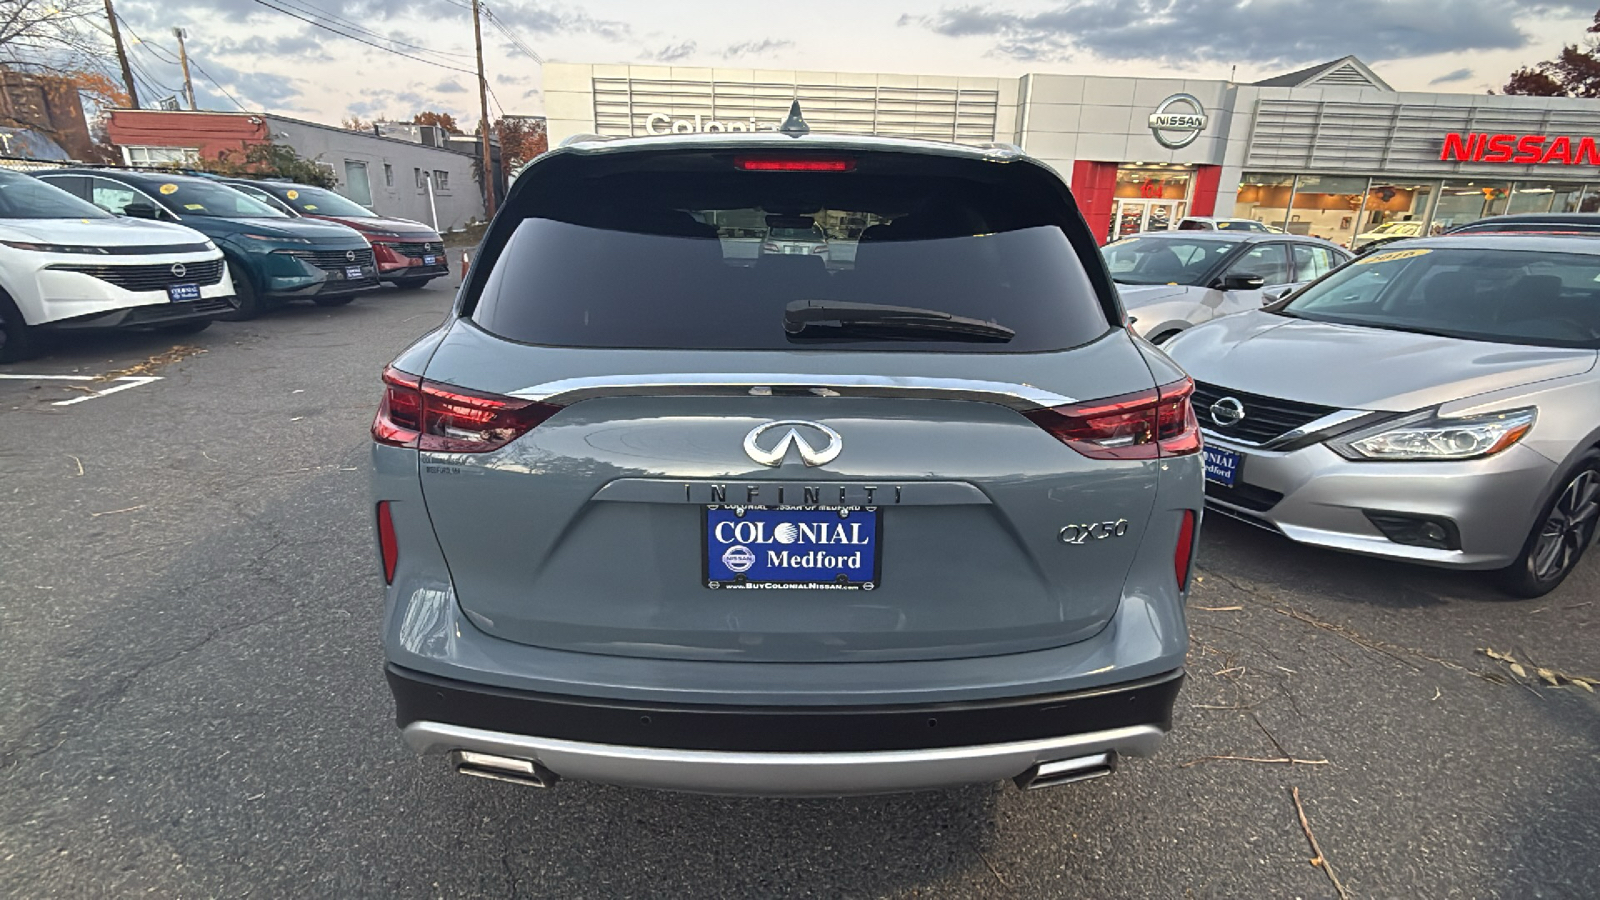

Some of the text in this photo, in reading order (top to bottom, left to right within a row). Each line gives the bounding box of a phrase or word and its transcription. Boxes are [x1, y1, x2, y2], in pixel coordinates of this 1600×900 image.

[1156, 116, 1203, 126] NISSAN
[1440, 132, 1600, 165] NISSAN
[684, 484, 902, 503] INFINITI
[714, 521, 869, 545] COLONIAL
[1058, 518, 1128, 544] QX50
[767, 550, 861, 569] Medford
